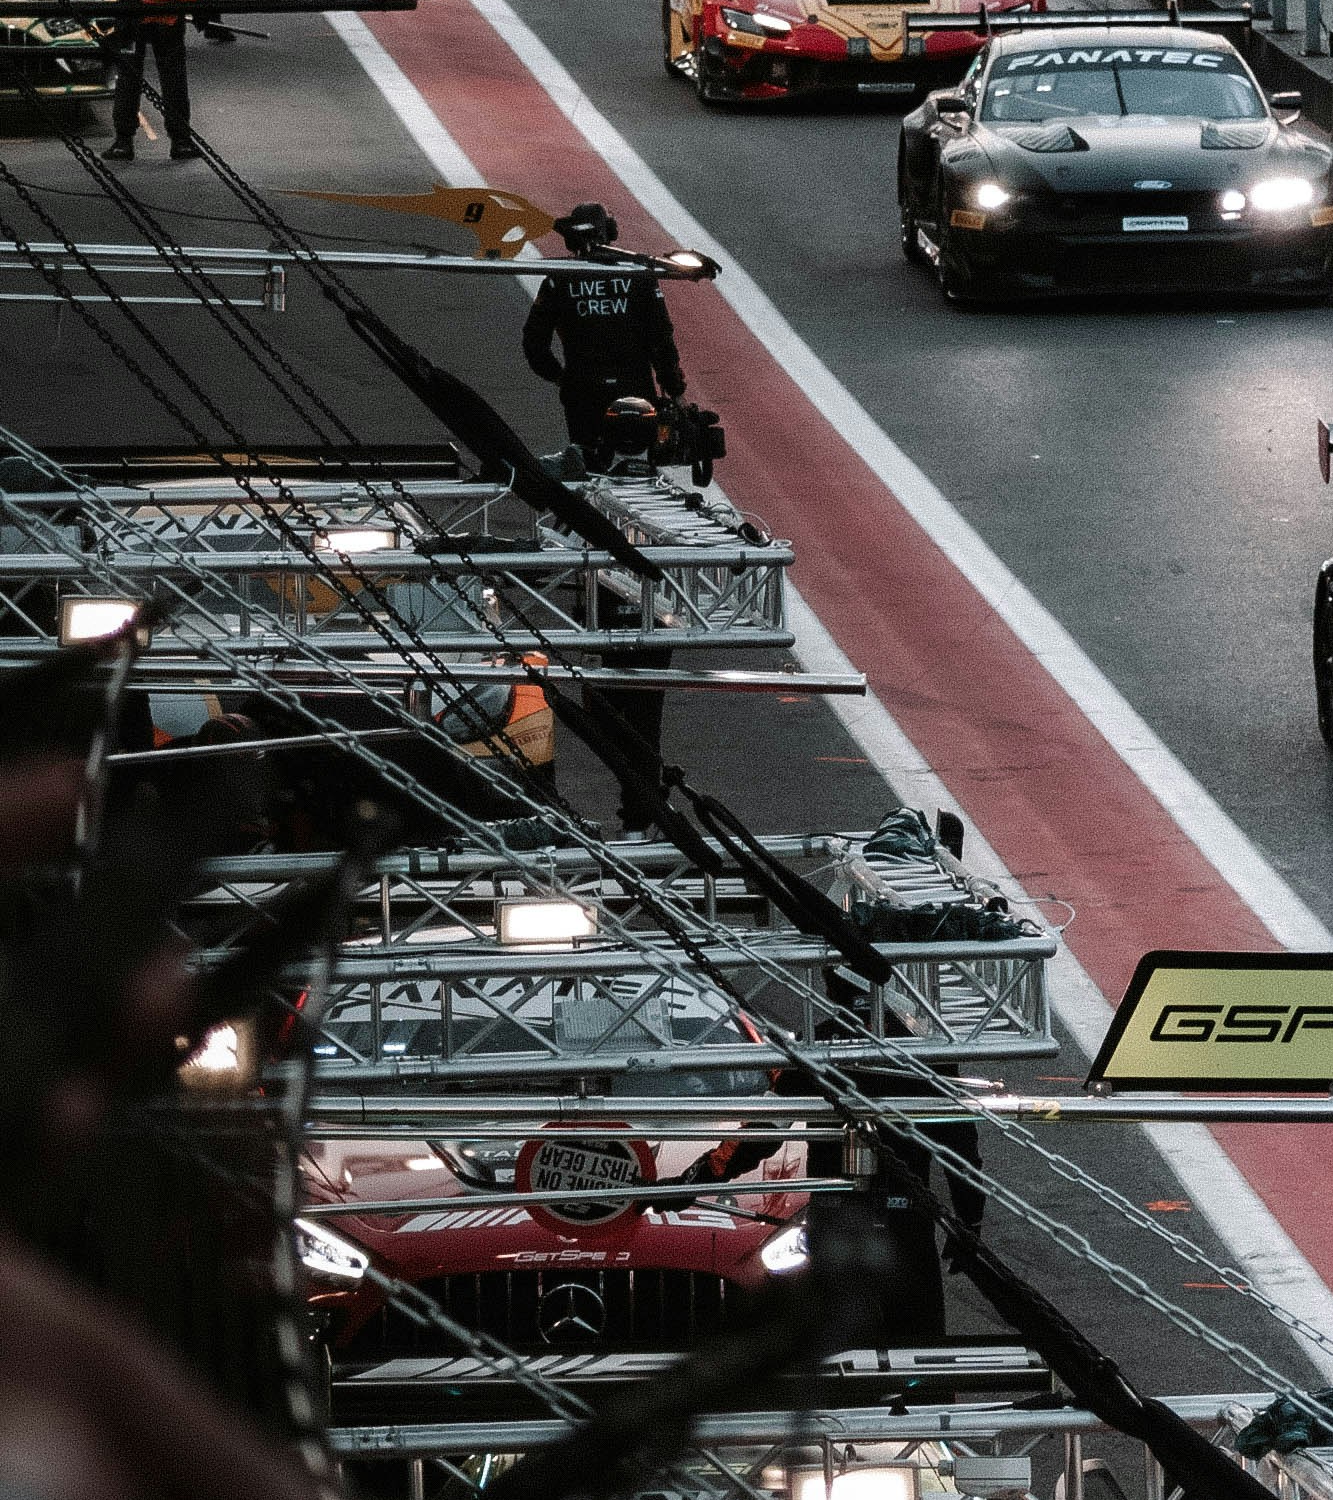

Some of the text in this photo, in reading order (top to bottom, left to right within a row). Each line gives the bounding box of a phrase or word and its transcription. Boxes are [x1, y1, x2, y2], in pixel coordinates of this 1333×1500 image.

[1007, 49, 1224, 72] FANATEC
[569, 279, 632, 298] LIVE TV
[577, 298, 628, 316] CREW
